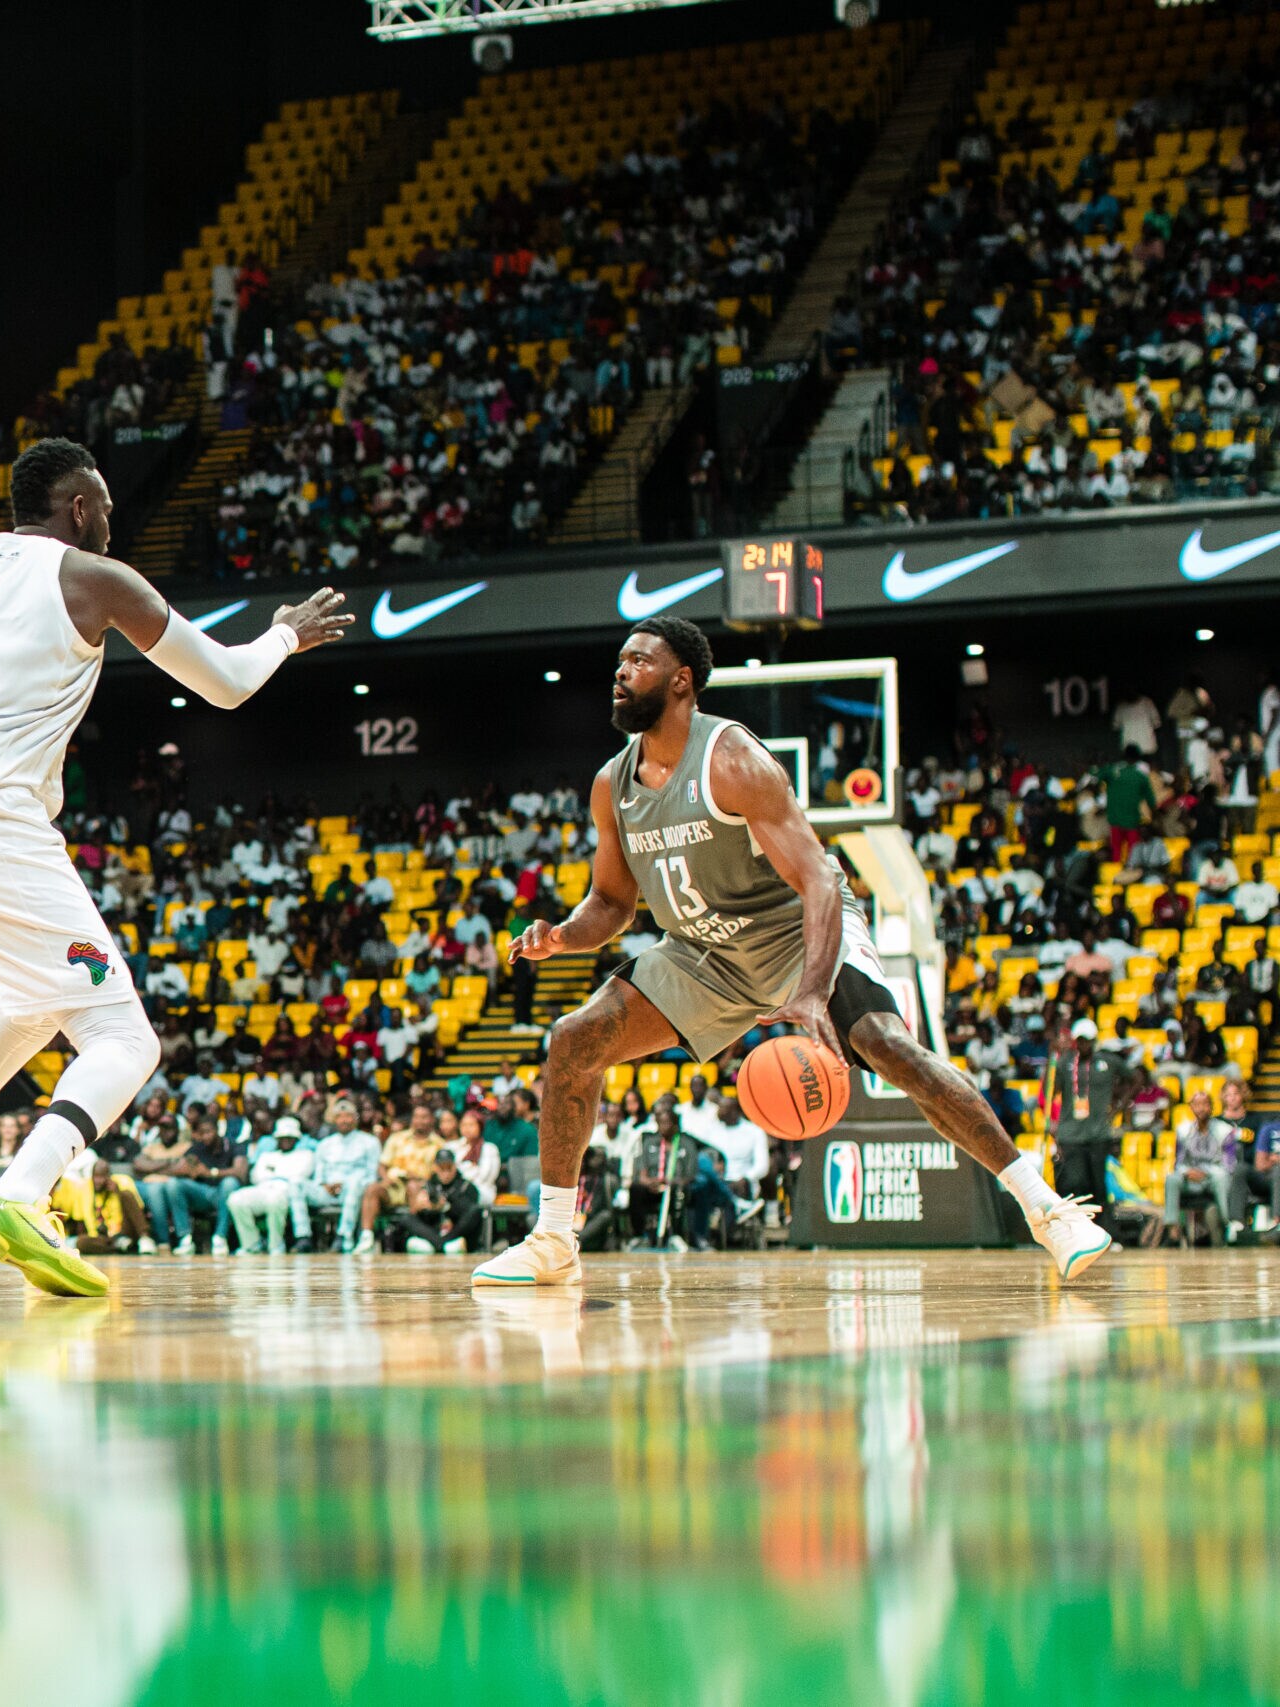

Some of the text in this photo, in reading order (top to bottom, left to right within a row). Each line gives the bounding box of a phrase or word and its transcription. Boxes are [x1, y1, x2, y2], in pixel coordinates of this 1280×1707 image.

[743, 541, 793, 570] 2:14
[764, 571, 787, 615] 7
[1042, 676, 1109, 717] 101
[353, 716, 419, 756] 122
[626, 819, 714, 854] RIVERS HOOPERS
[654, 855, 709, 921] 13
[679, 912, 724, 938] VISIT
[791, 1046, 824, 1113] Wilson
[863, 1142, 959, 1170] BASKETBALL
[864, 1168, 921, 1195] AFRICA
[864, 1193, 924, 1222] LEAGUE
